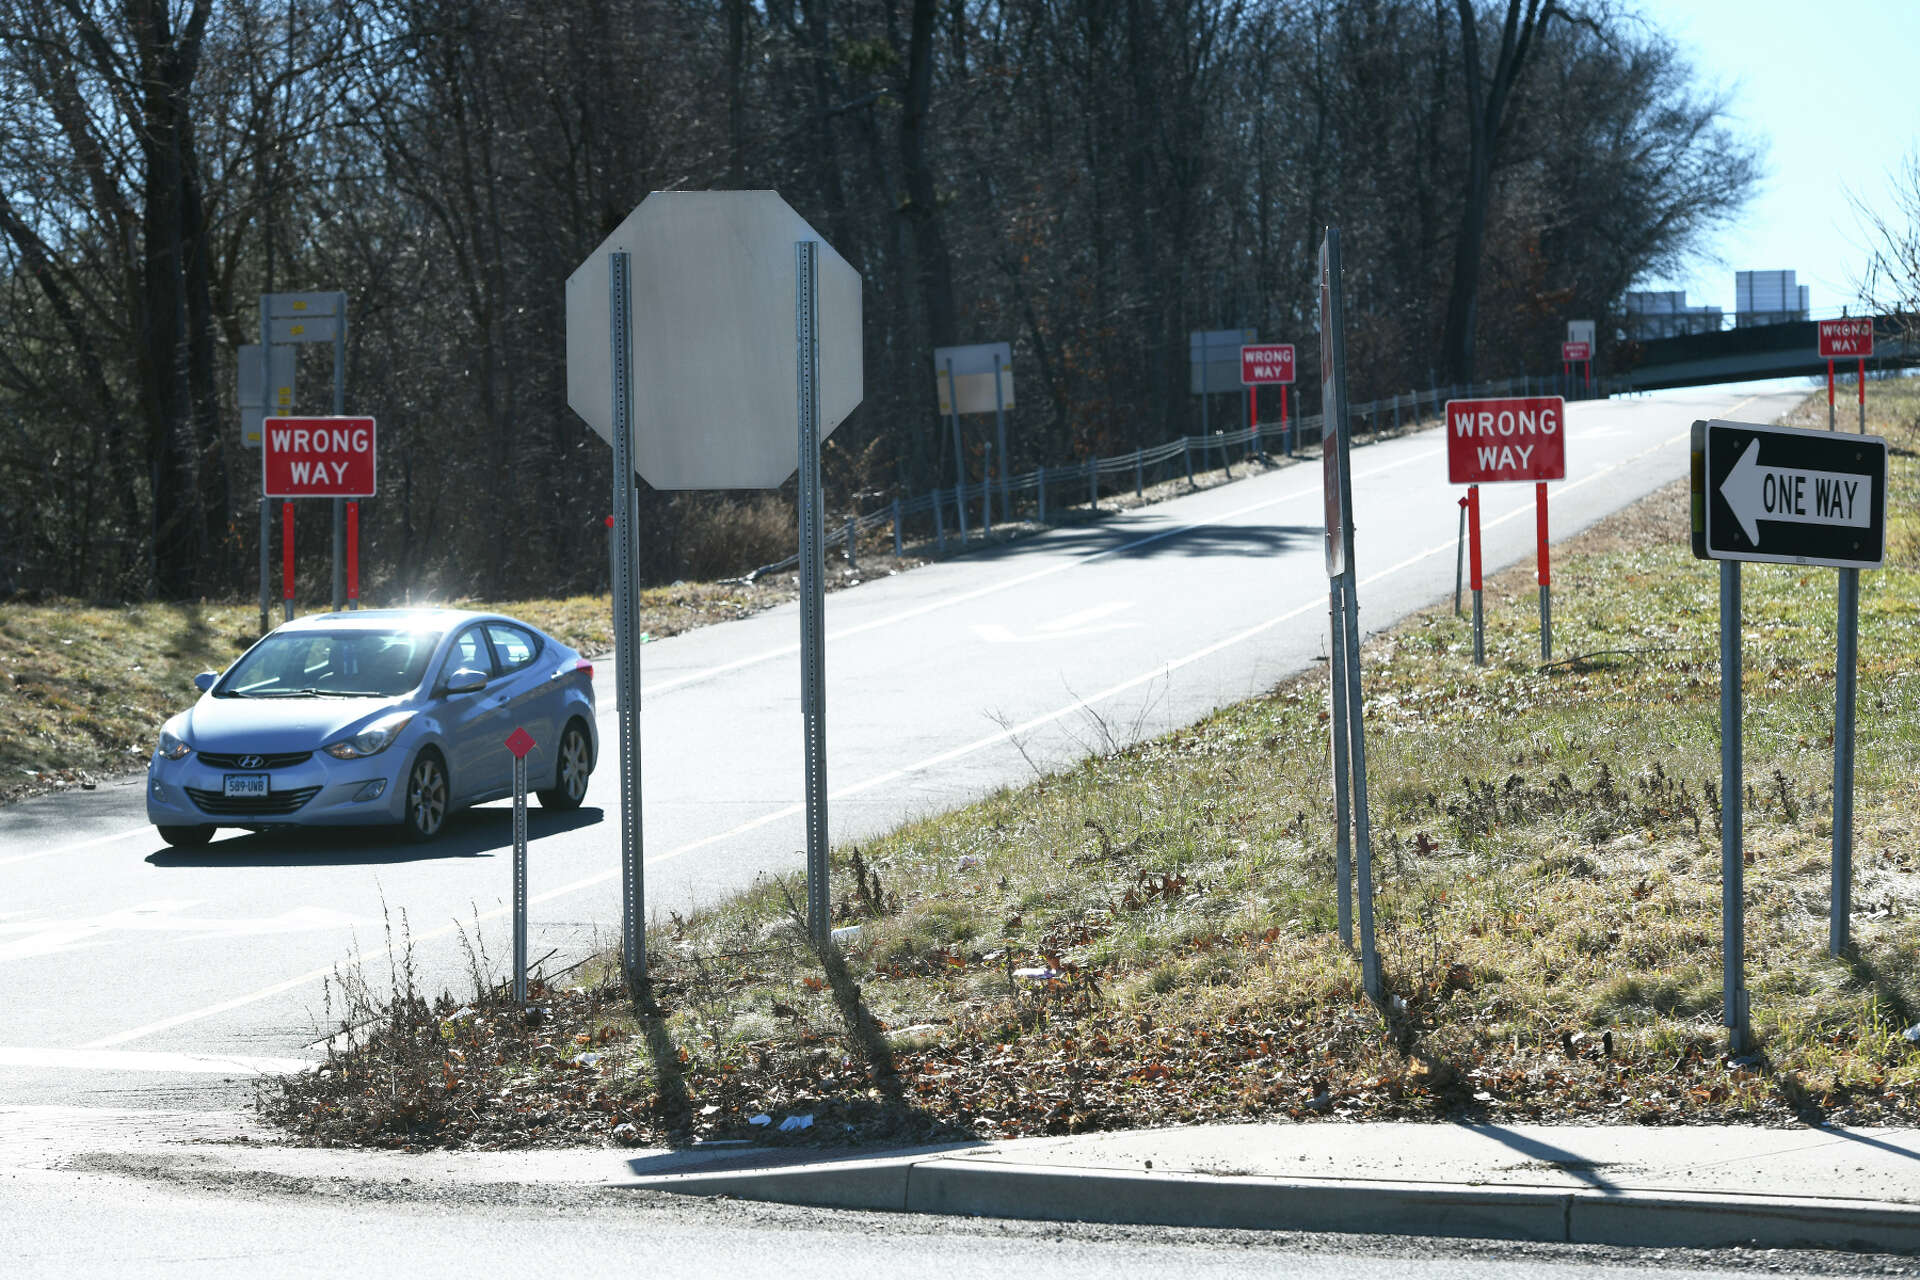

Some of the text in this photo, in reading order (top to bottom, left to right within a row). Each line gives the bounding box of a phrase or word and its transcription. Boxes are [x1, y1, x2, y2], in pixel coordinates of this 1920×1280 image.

[1245, 350, 1291, 363] WRONG
[1254, 366, 1282, 378] WAY
[1454, 409, 1557, 438] WRONG
[271, 429, 369, 453] WRONG
[1477, 444, 1534, 471] WAY
[290, 461, 349, 485] WAY
[1763, 472, 1859, 520] ONE WAY
